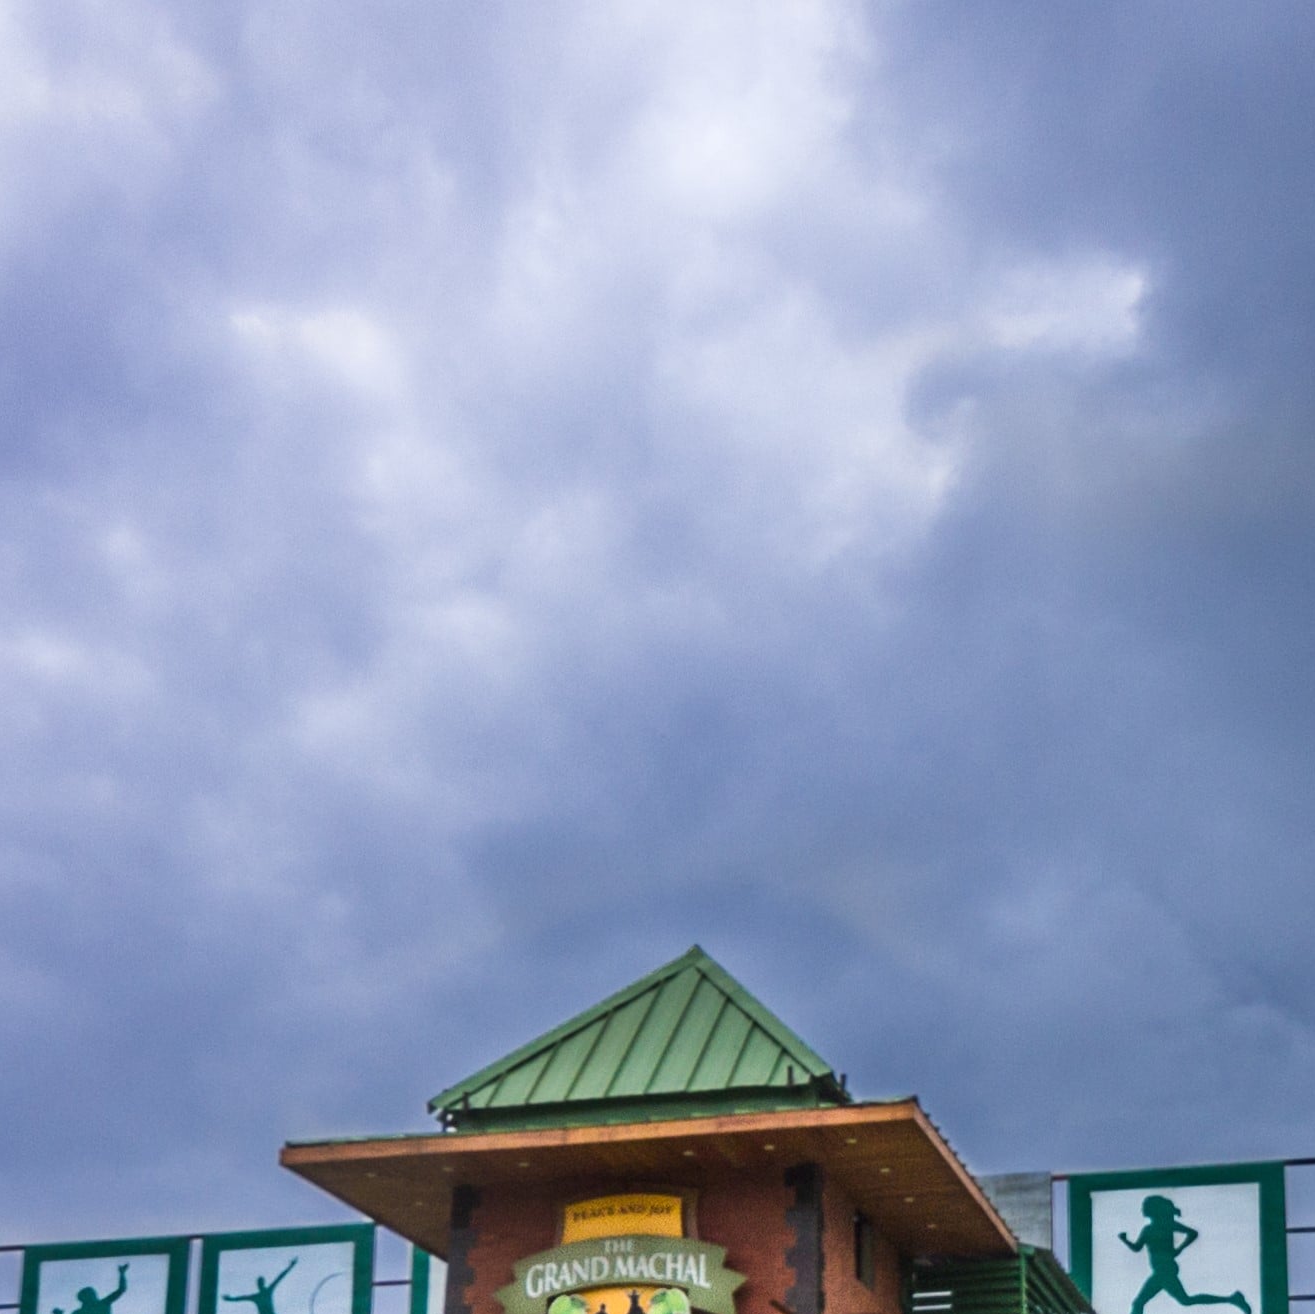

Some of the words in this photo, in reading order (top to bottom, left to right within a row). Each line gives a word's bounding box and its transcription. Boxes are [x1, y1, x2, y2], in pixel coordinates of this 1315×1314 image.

[604, 1239, 634, 1253] THE
[526, 1257, 609, 1297] GRAND
[614, 1252, 711, 1289] MACHAL
